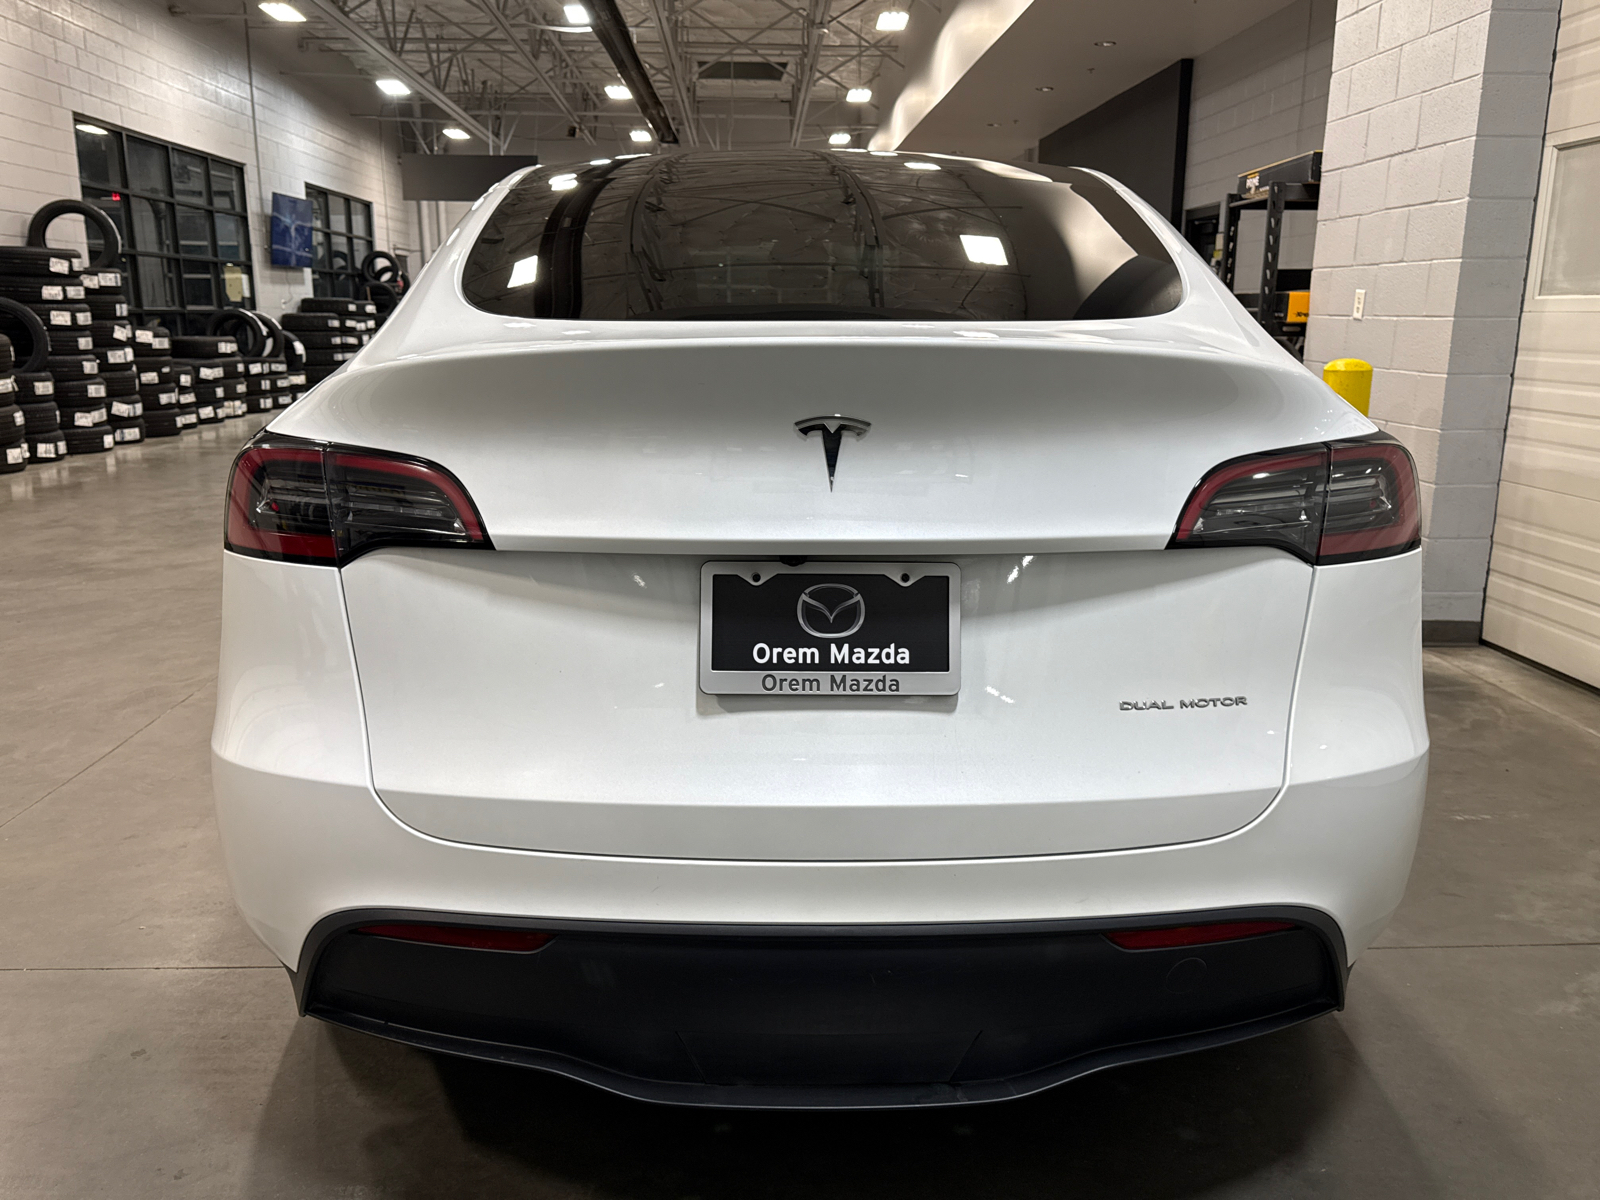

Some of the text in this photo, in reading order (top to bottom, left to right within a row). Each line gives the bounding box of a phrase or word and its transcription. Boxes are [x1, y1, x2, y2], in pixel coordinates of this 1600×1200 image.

[752, 643, 910, 664] Orem Mazda
[761, 674, 900, 692] Orem Mazda
[1119, 696, 1248, 711] DUAL MOTOR
